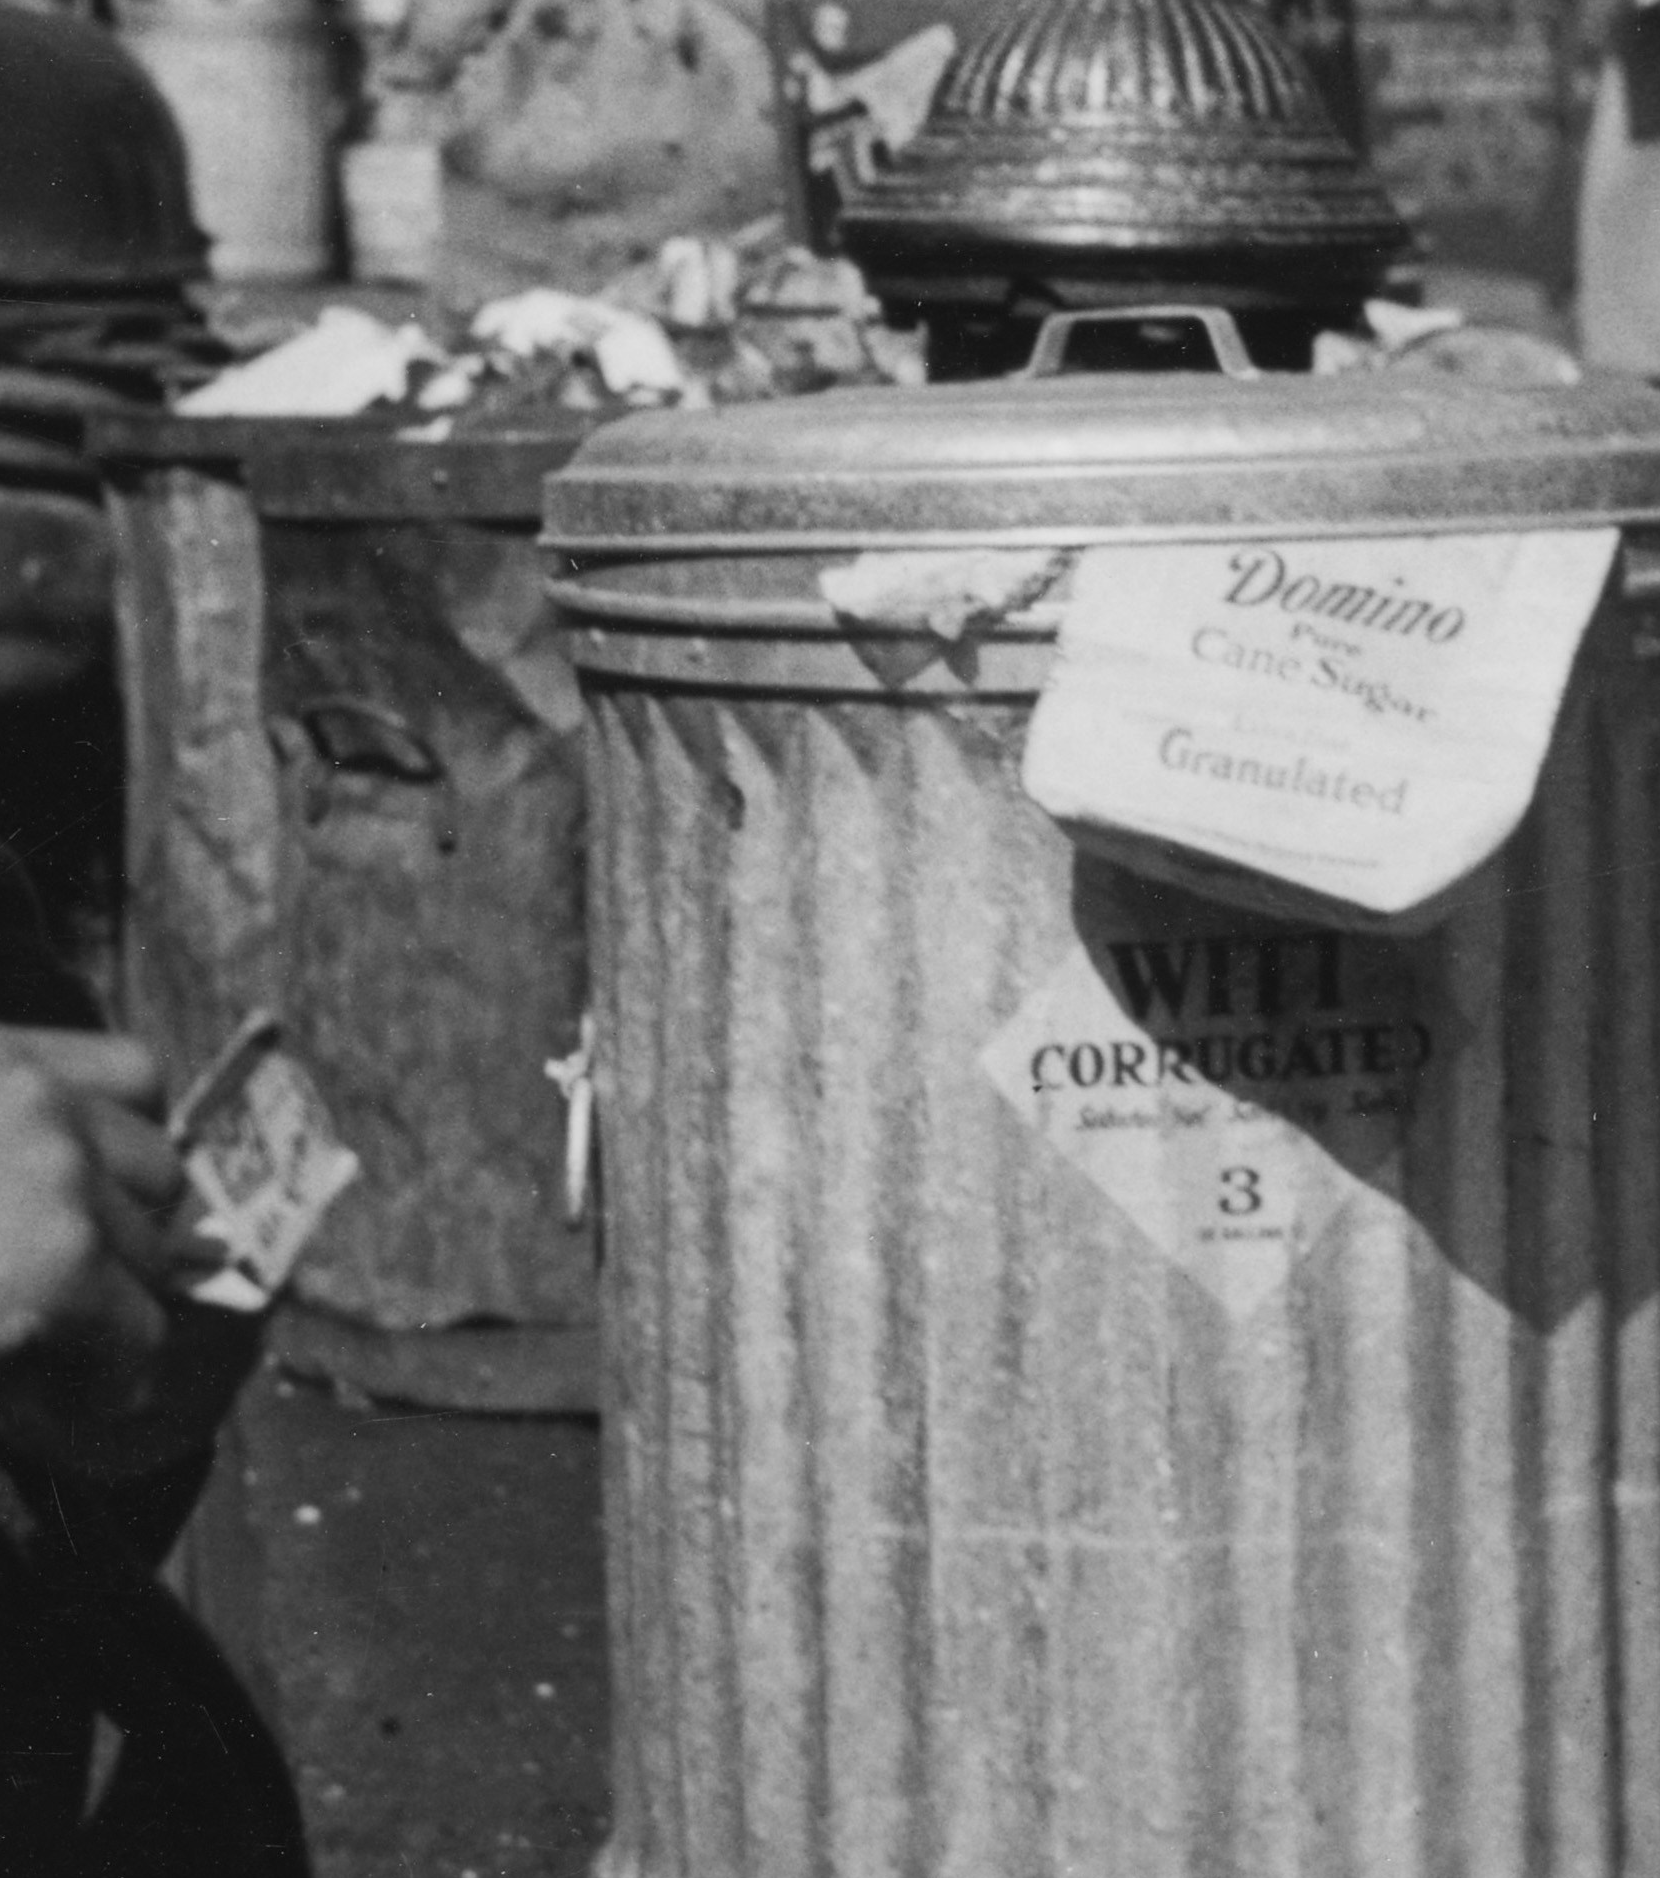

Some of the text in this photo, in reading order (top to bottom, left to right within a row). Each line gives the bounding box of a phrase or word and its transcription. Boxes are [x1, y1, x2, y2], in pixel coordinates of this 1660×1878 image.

[1223, 548, 1467, 644] Domino
[1289, 620, 1362, 658] Pure
[1190, 624, 1439, 722] Cane Sugar
[1158, 725, 1409, 814] Granulated
[1106, 930, 1344, 1020] WITT
[1217, 1165, 1263, 1216] 3
